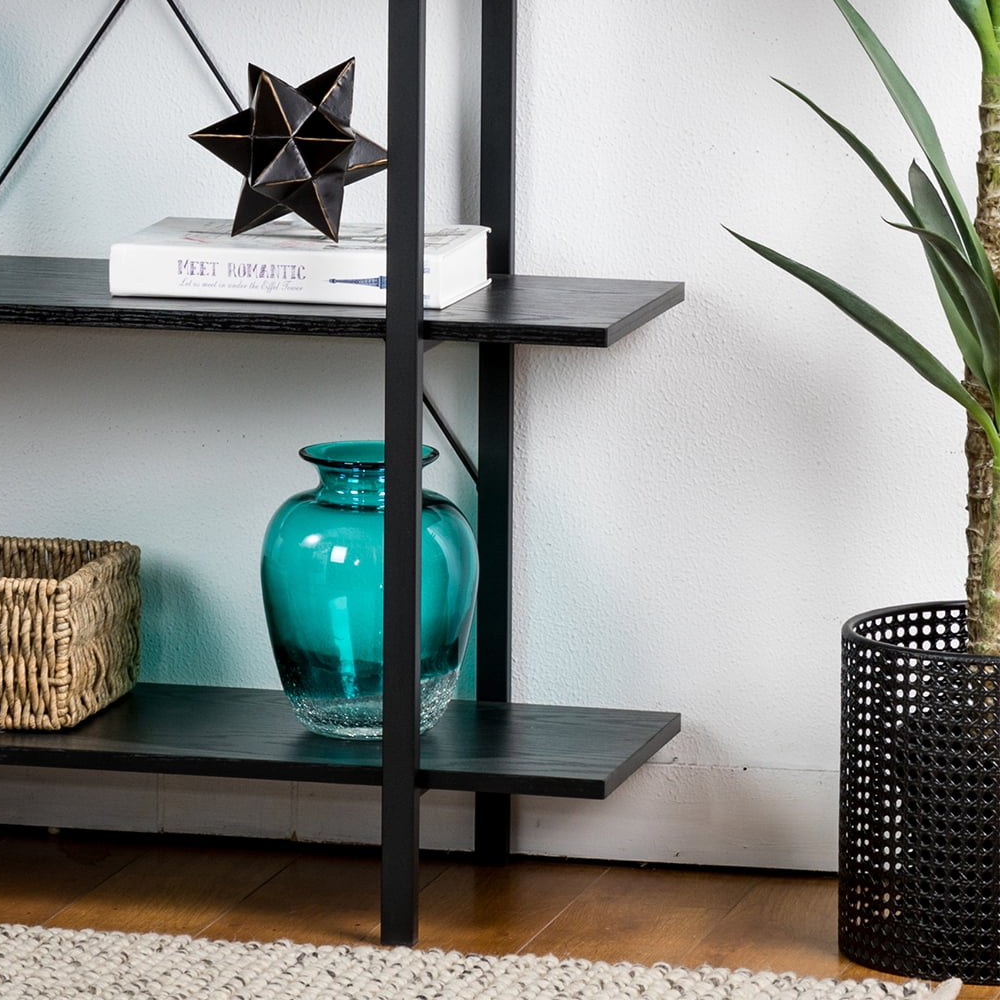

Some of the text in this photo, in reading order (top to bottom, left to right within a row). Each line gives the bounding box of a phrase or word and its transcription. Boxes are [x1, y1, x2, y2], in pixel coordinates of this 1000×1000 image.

[177, 259, 307, 280] MEET ROMANTIC
[248, 280, 261, 290] the
[260, 279, 280, 294] Eiffel
